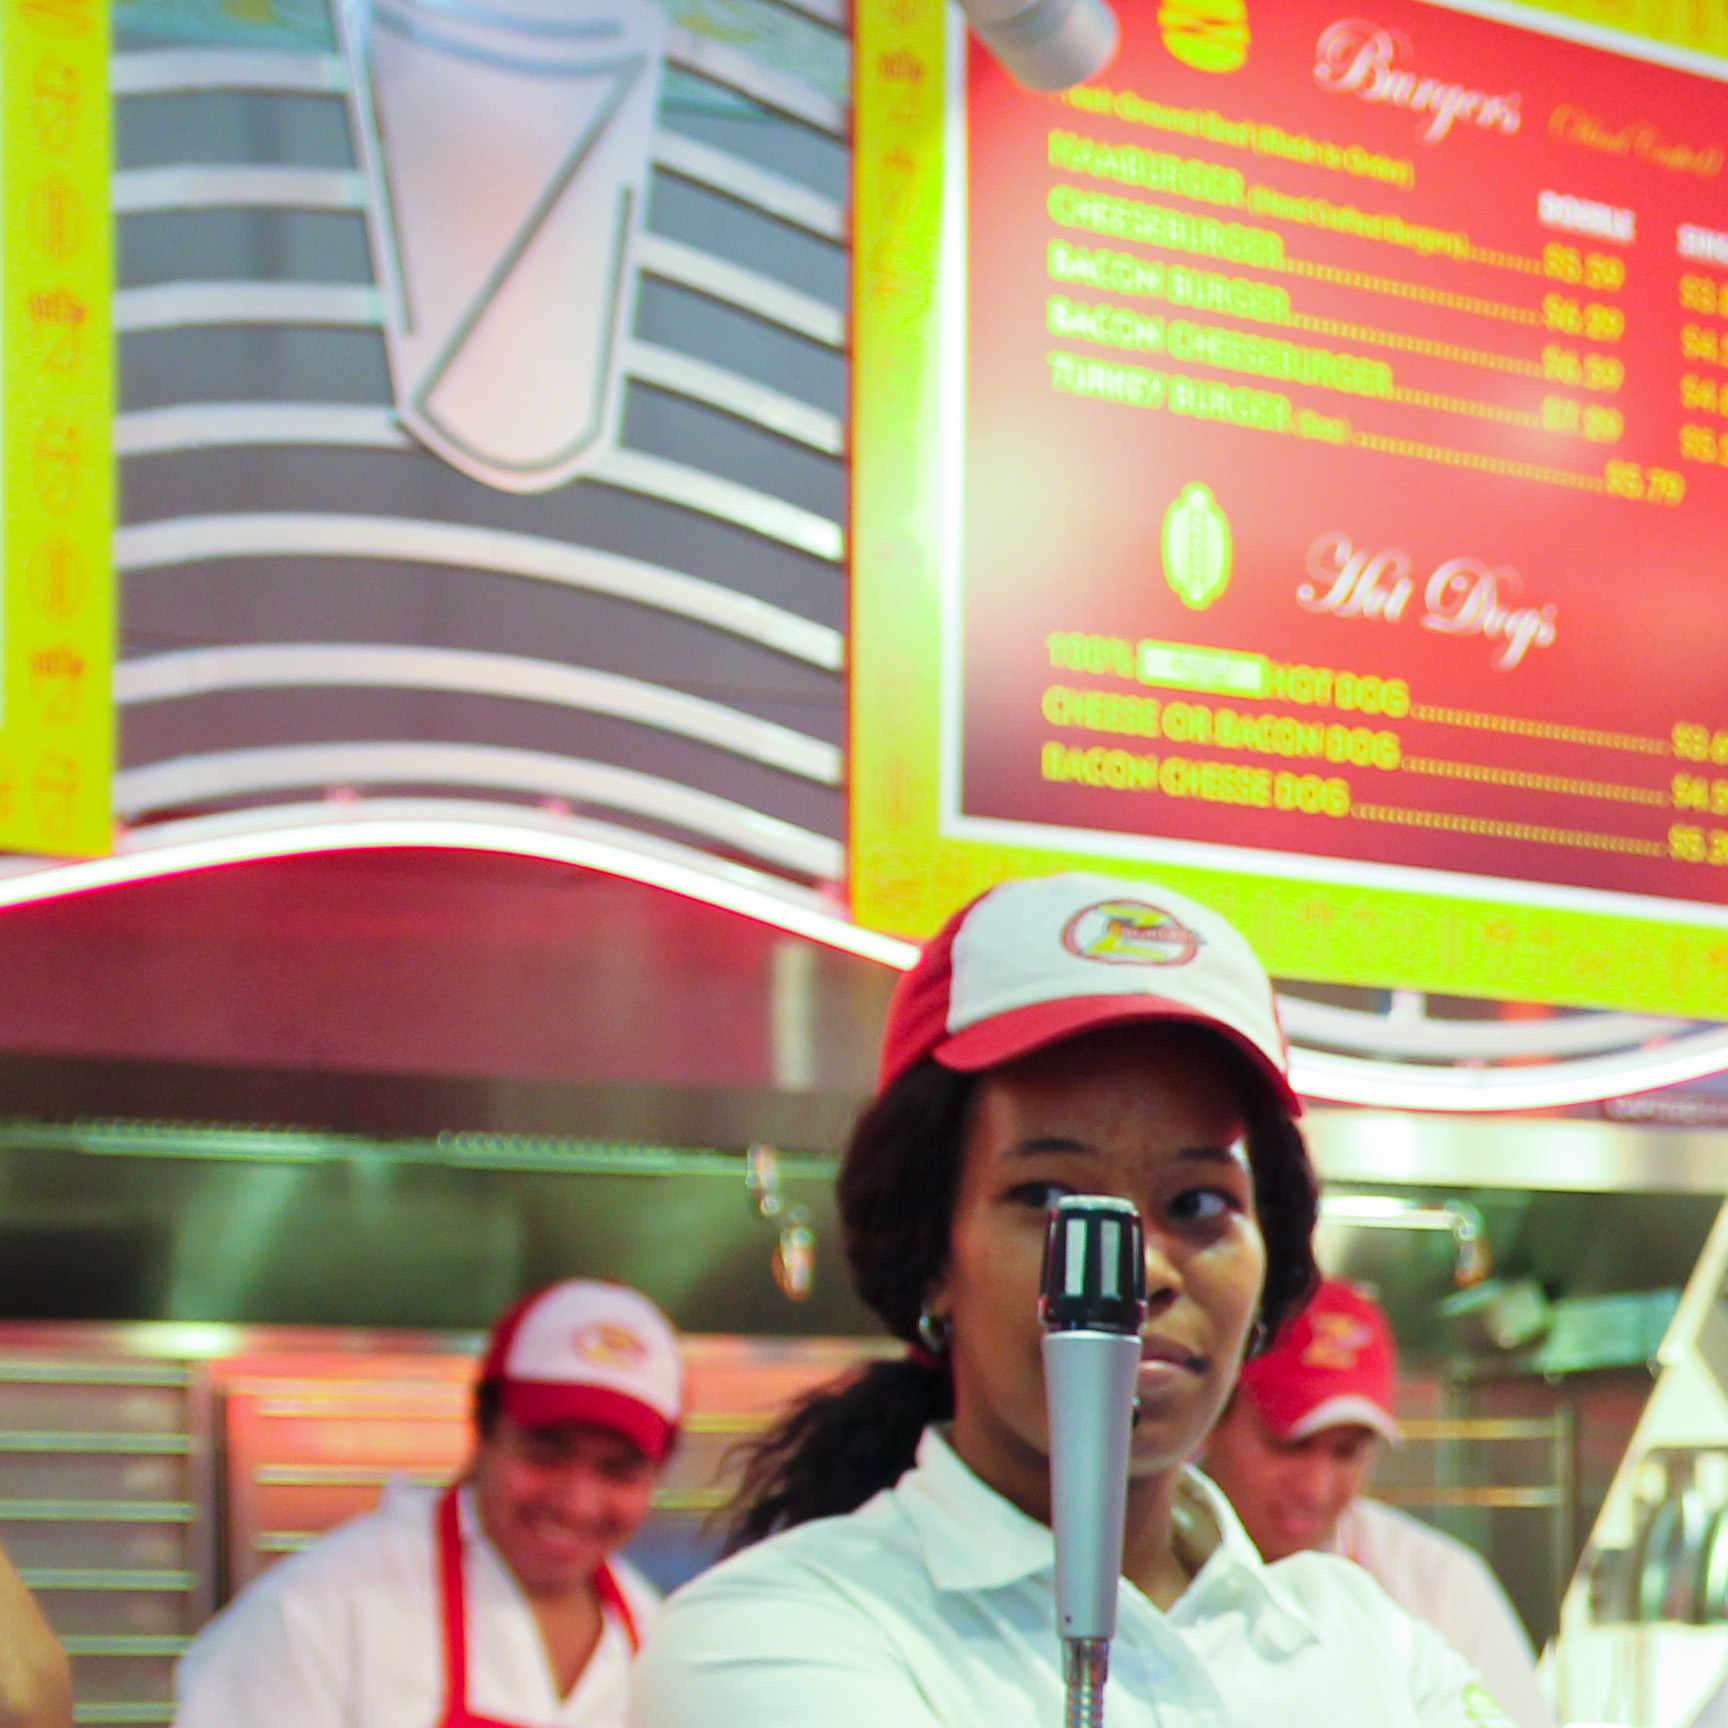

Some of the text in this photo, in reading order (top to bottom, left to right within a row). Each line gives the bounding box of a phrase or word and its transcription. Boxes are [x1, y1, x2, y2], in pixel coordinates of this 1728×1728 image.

[1313, 16, 1522, 146] Burgers
[1048, 127, 1246, 208] HAMBURGER
[1046, 182, 1284, 270] CHEESEBURGER
[1537, 189, 1636, 246] DOUBLE
[1046, 239, 1166, 298] BACON
[1166, 264, 1290, 326] BURGER
[1046, 294, 1166, 353] BACON
[1166, 319, 1393, 399] CHEESEBURGER
[1046, 350, 1167, 410] TURKEY
[1167, 373, 1292, 435] BURGER
[1295, 531, 1559, 671] Hot Dogs
[1041, 684, 1161, 738] CHEESE
[1161, 700, 1213, 745] OR
[1213, 707, 1326, 758] BACON
[1324, 724, 1402, 770] DOG
[1270, 663, 1333, 707] HOT
[1333, 671, 1410, 719] DOG
[1041, 740, 1159, 790] BACON
[1158, 756, 1273, 807] CHEESE
[1273, 770, 1351, 818] DOG
